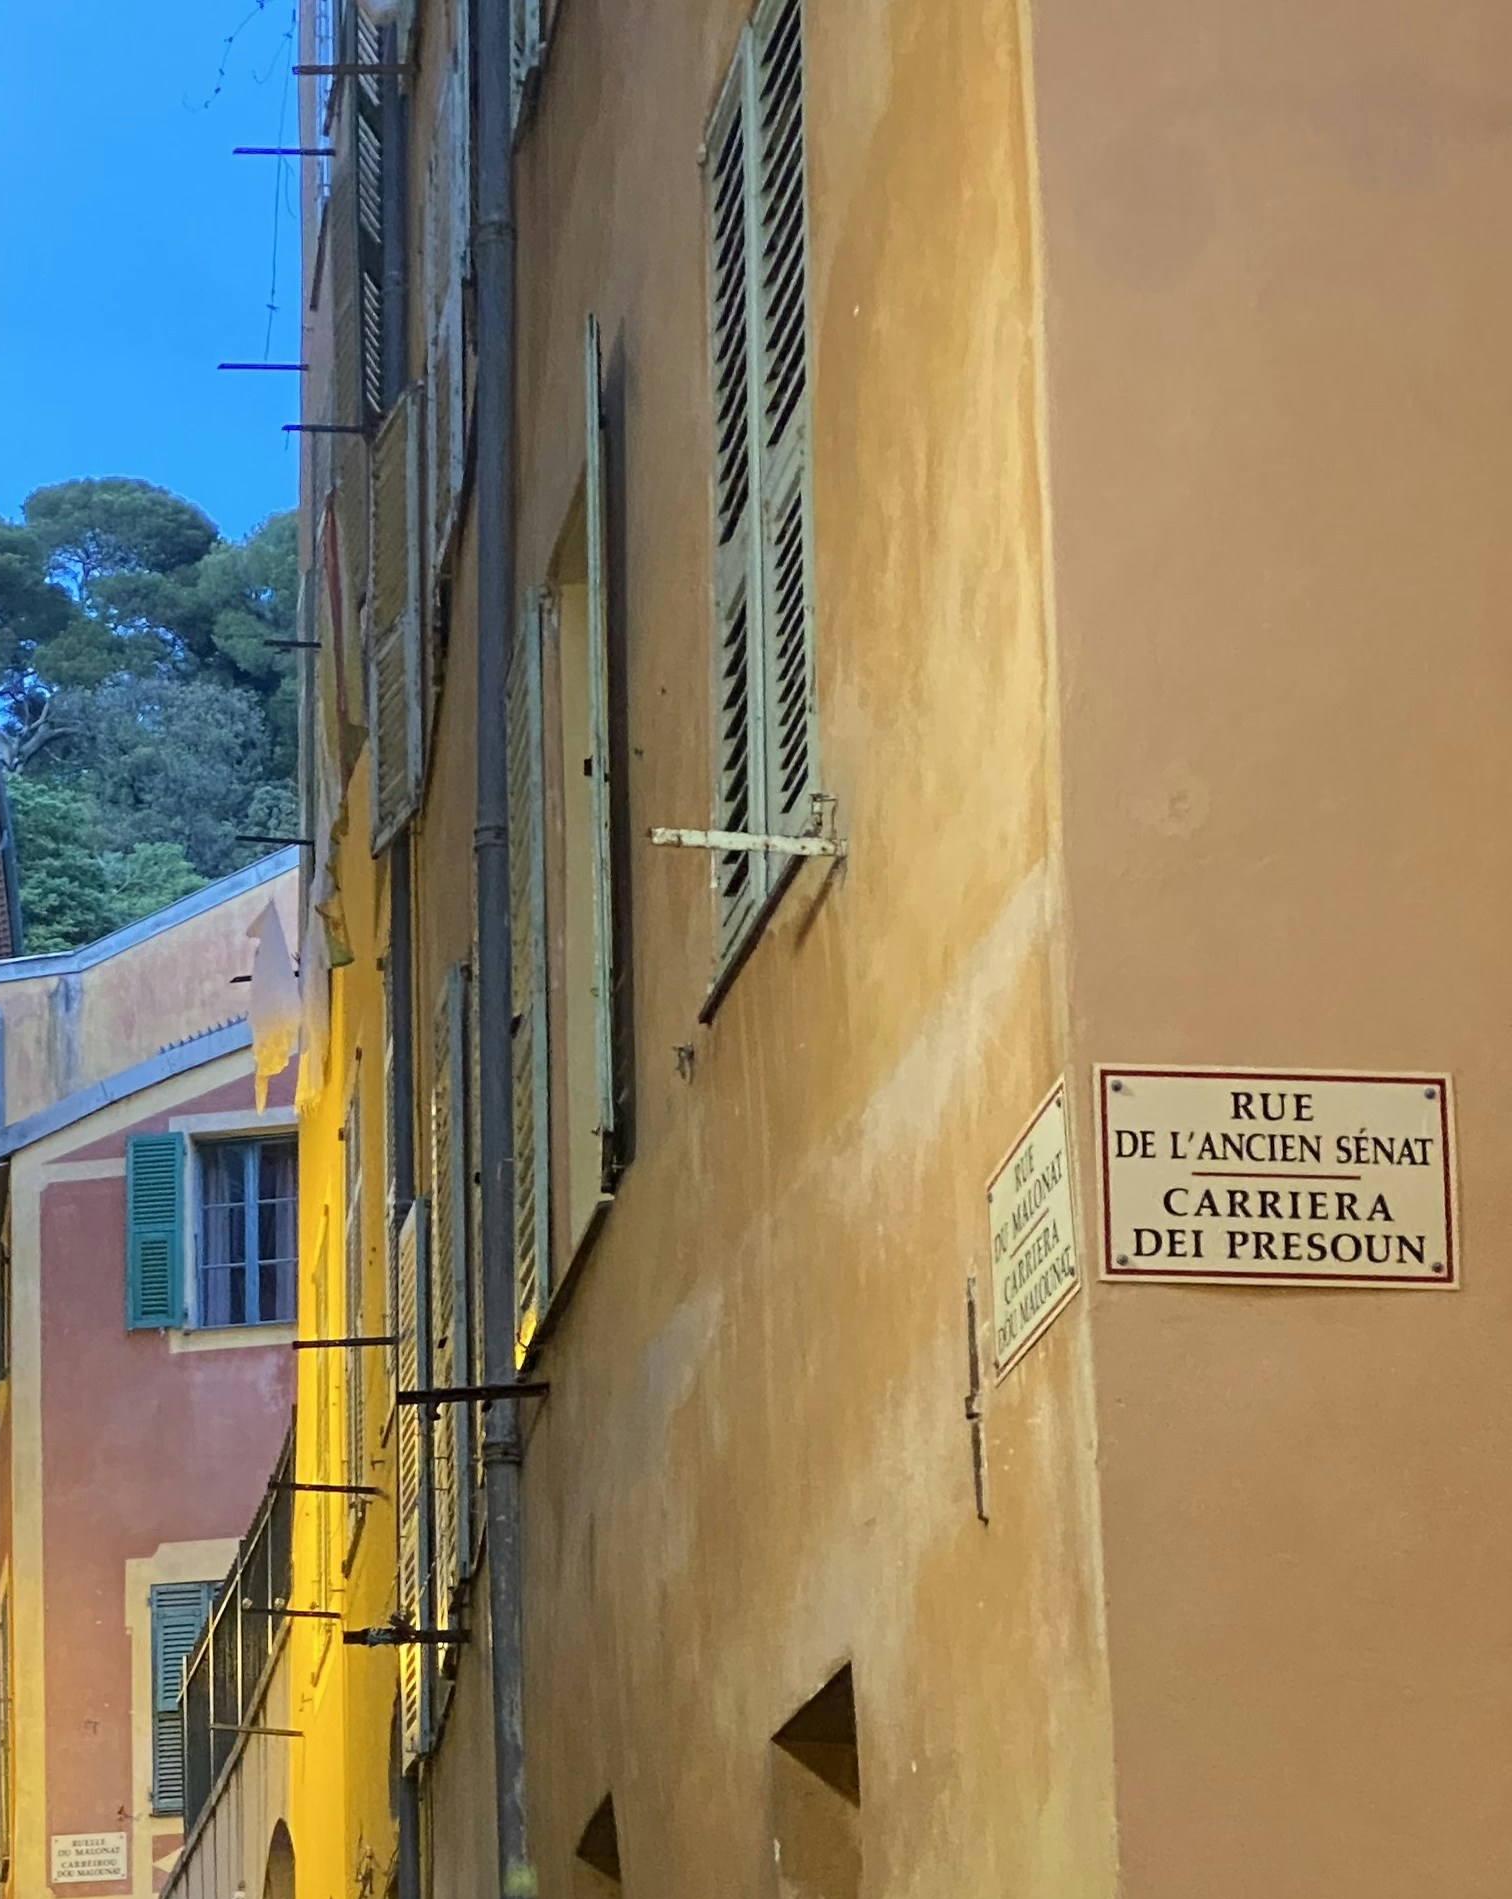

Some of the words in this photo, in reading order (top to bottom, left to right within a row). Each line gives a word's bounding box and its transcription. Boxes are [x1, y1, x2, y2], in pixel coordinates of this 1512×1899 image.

[1230, 1091, 1315, 1122] RUE
[1013, 1144, 1035, 1193] RUE
[1114, 1129, 1156, 1160] DE
[1170, 1131, 1321, 1164] L'ANCIEN
[1335, 1127, 1434, 1167] SÉNAT
[994, 1222, 1009, 1264] DU
[1011, 1151, 1063, 1239] MALONAT
[1162, 1187, 1396, 1223] CARRIERA
[1004, 1218, 1060, 1307] CARRIERA
[1132, 1228, 1204, 1259] DEI
[1226, 1230, 1428, 1266] PRESOUN
[1019, 1246, 1072, 1332] MALOUNAT
